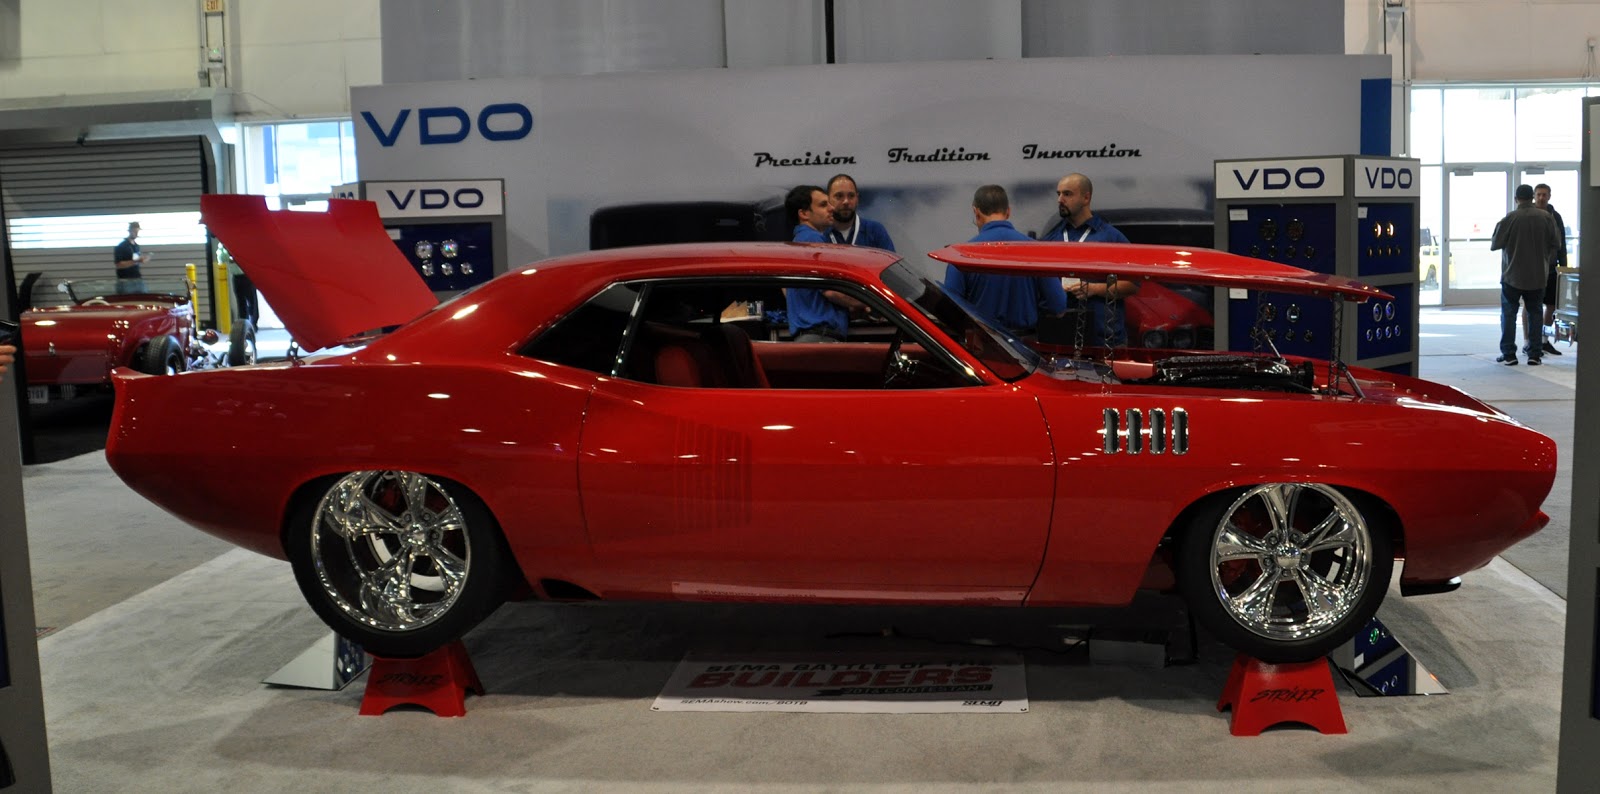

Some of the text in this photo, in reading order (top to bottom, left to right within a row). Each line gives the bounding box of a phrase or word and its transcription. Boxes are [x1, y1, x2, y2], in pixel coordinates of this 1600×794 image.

[206, 0, 218, 10] EXIT
[360, 103, 533, 147] VDO
[753, 143, 1143, 168] Precision Tradition Innovation
[1233, 167, 1325, 190] VDO
[1365, 167, 1413, 189] VDO
[386, 188, 484, 210] VDO
[686, 666, 994, 689] BUILDERS
[706, 664, 780, 672] SEMA
[793, 663, 888, 672] BATTLE
[900, 661, 930, 670] OF
[879, 685, 992, 694] CONTESTANT
[1250, 686, 1325, 703] STRIKER
